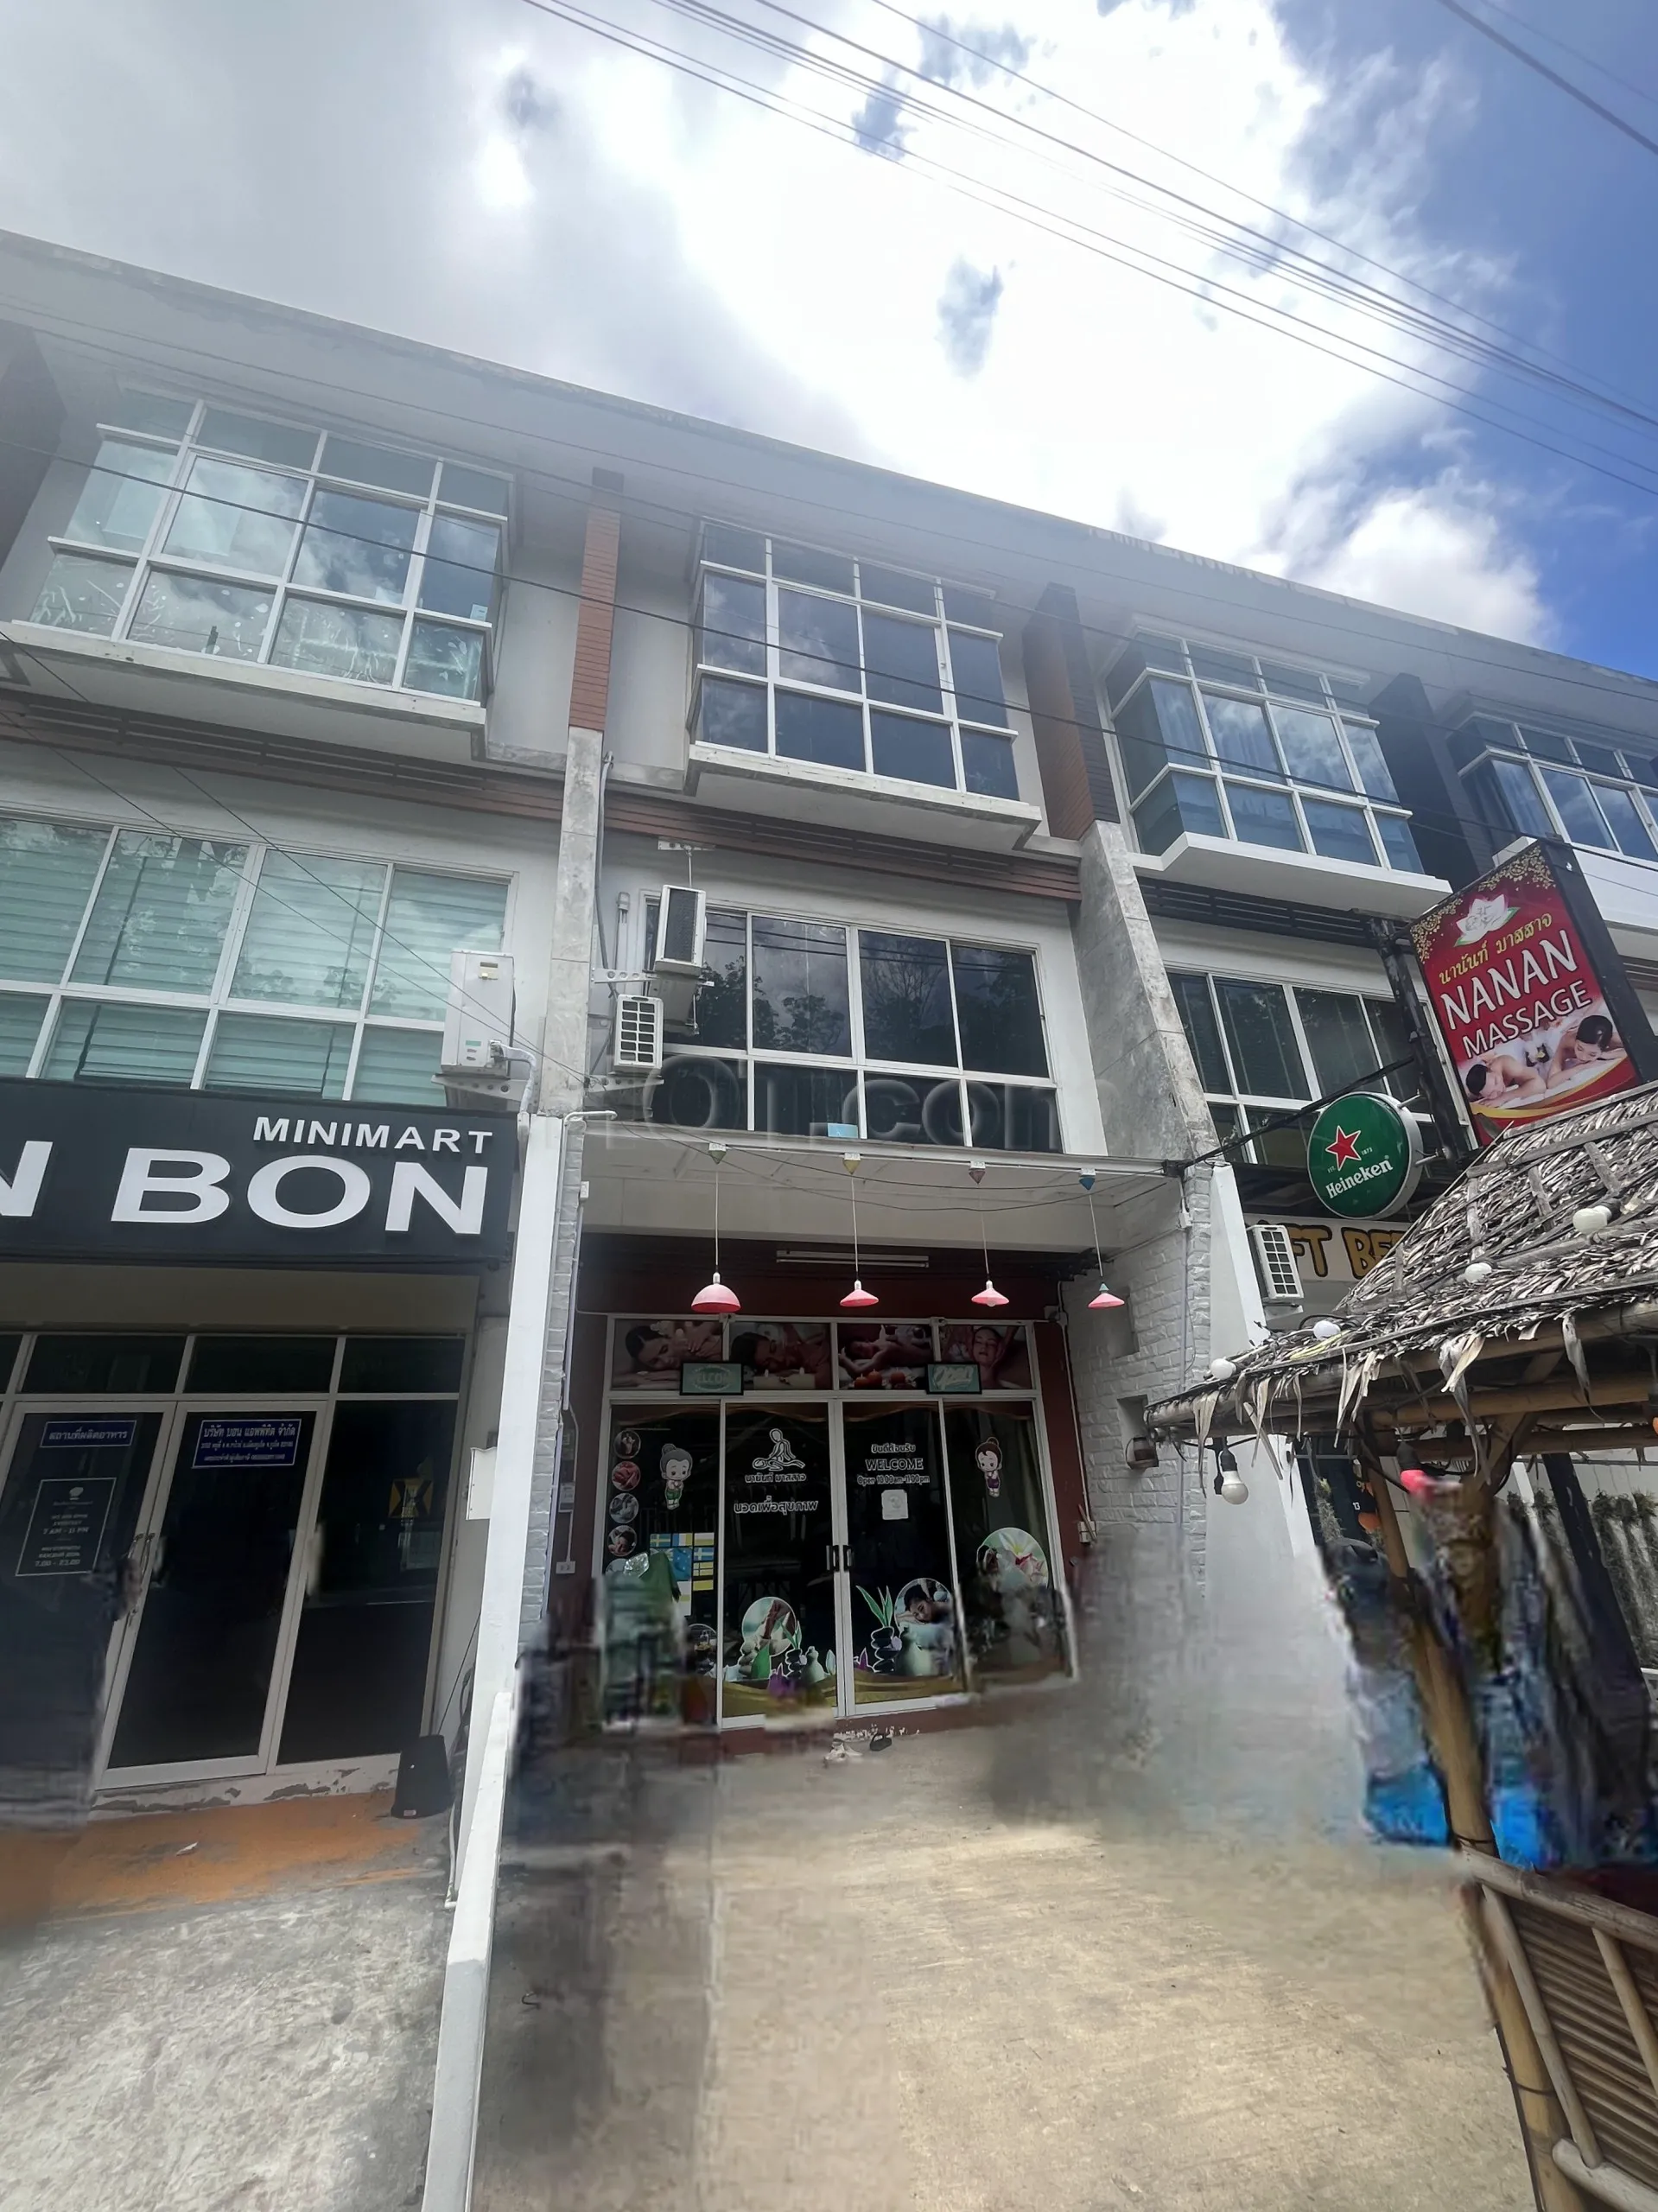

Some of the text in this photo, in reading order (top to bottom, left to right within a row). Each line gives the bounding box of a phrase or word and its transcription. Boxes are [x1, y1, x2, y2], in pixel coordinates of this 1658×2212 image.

[1440, 929, 1578, 1030] NANAN
[1462, 979, 1592, 1059] MASSAGE
[253, 1116, 493, 1154] MINIMART
[111, 1147, 489, 1236] BON
[1325, 1160, 1394, 1199] Heineken
[865, 1458, 924, 1471] WELCOME
[734, 1495, 819, 1516] นวดเพื่อสุขภาพ
